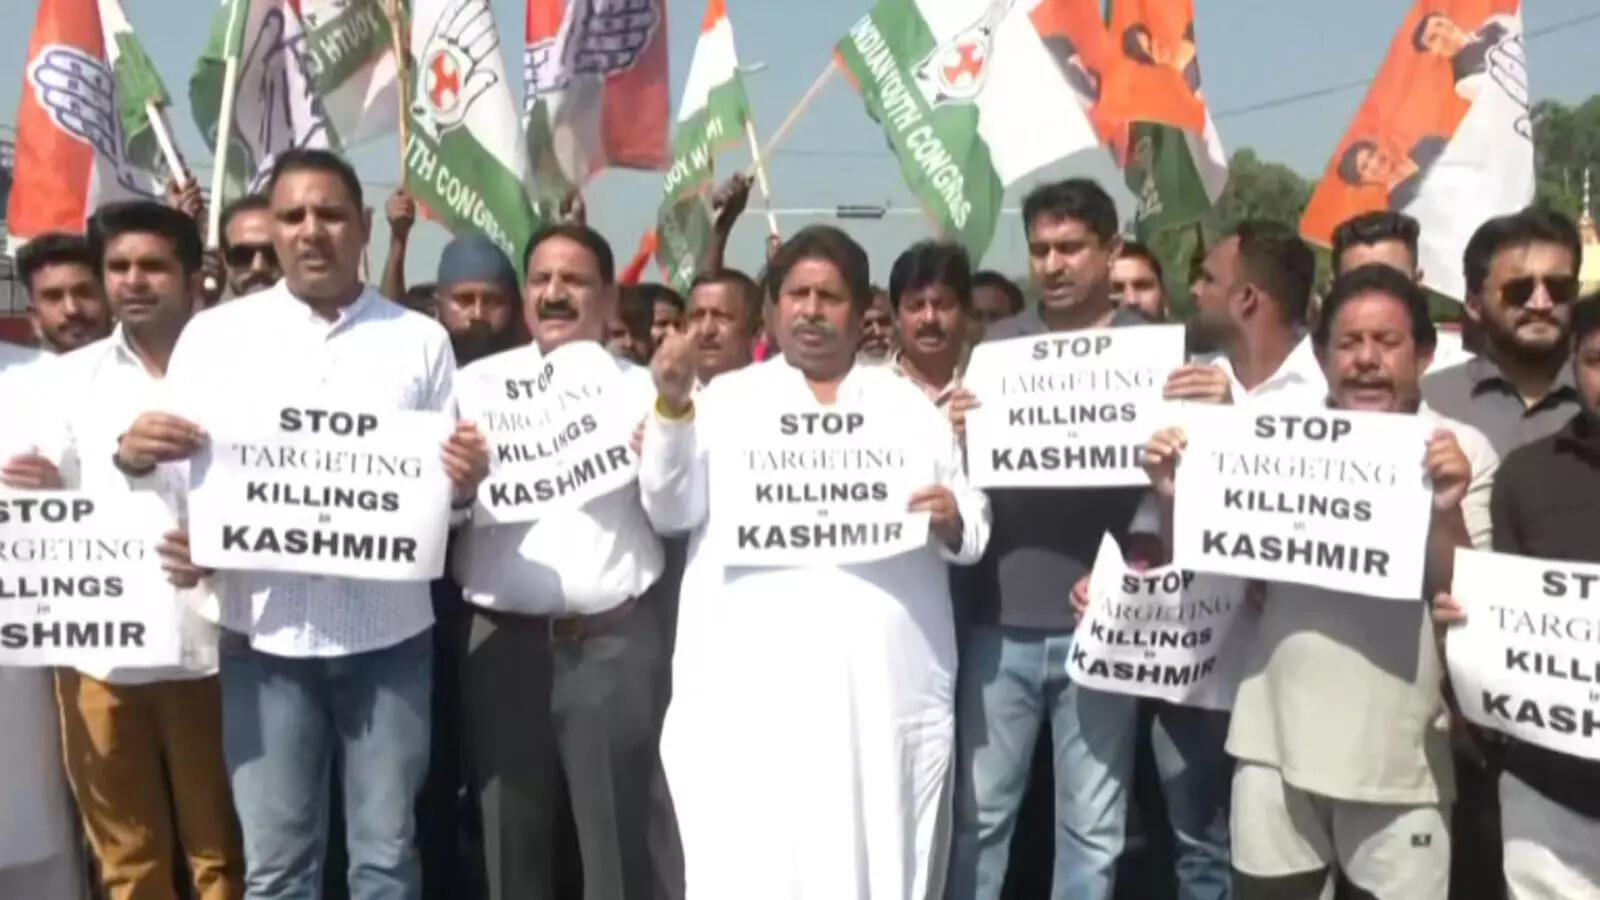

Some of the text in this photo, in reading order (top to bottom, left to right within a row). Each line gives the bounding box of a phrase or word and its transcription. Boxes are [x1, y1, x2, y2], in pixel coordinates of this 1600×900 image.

[1032, 335, 1112, 360] STOP
[505, 361, 554, 400] STOP
[279, 407, 378, 437] STOP
[780, 412, 865, 435] STOP
[1009, 403, 1137, 426] KILLINGS
[1254, 415, 1352, 441] STOP
[497, 413, 597, 463] KILLINGS
[231, 443, 422, 478] TARGETING
[743, 448, 905, 470] TARGETING
[1211, 450, 1396, 485] TARGETING
[489, 445, 631, 507] KASHMIR
[246, 481, 399, 511] KILLINGS
[755, 481, 888, 503] KILLINGS
[1224, 488, 1372, 522] KILLINGS
[221, 524, 417, 562] KASHMIR
[738, 521, 903, 549] KASHMIR
[1202, 529, 1390, 577] KASHMIR
[1122, 569, 1195, 595] STOP
[1102, 593, 1230, 622] ARGETING
[1090, 617, 1213, 649] KILLINGS
[1489, 604, 1600, 644] TARG
[1072, 643, 1217, 686] KASHMIR
